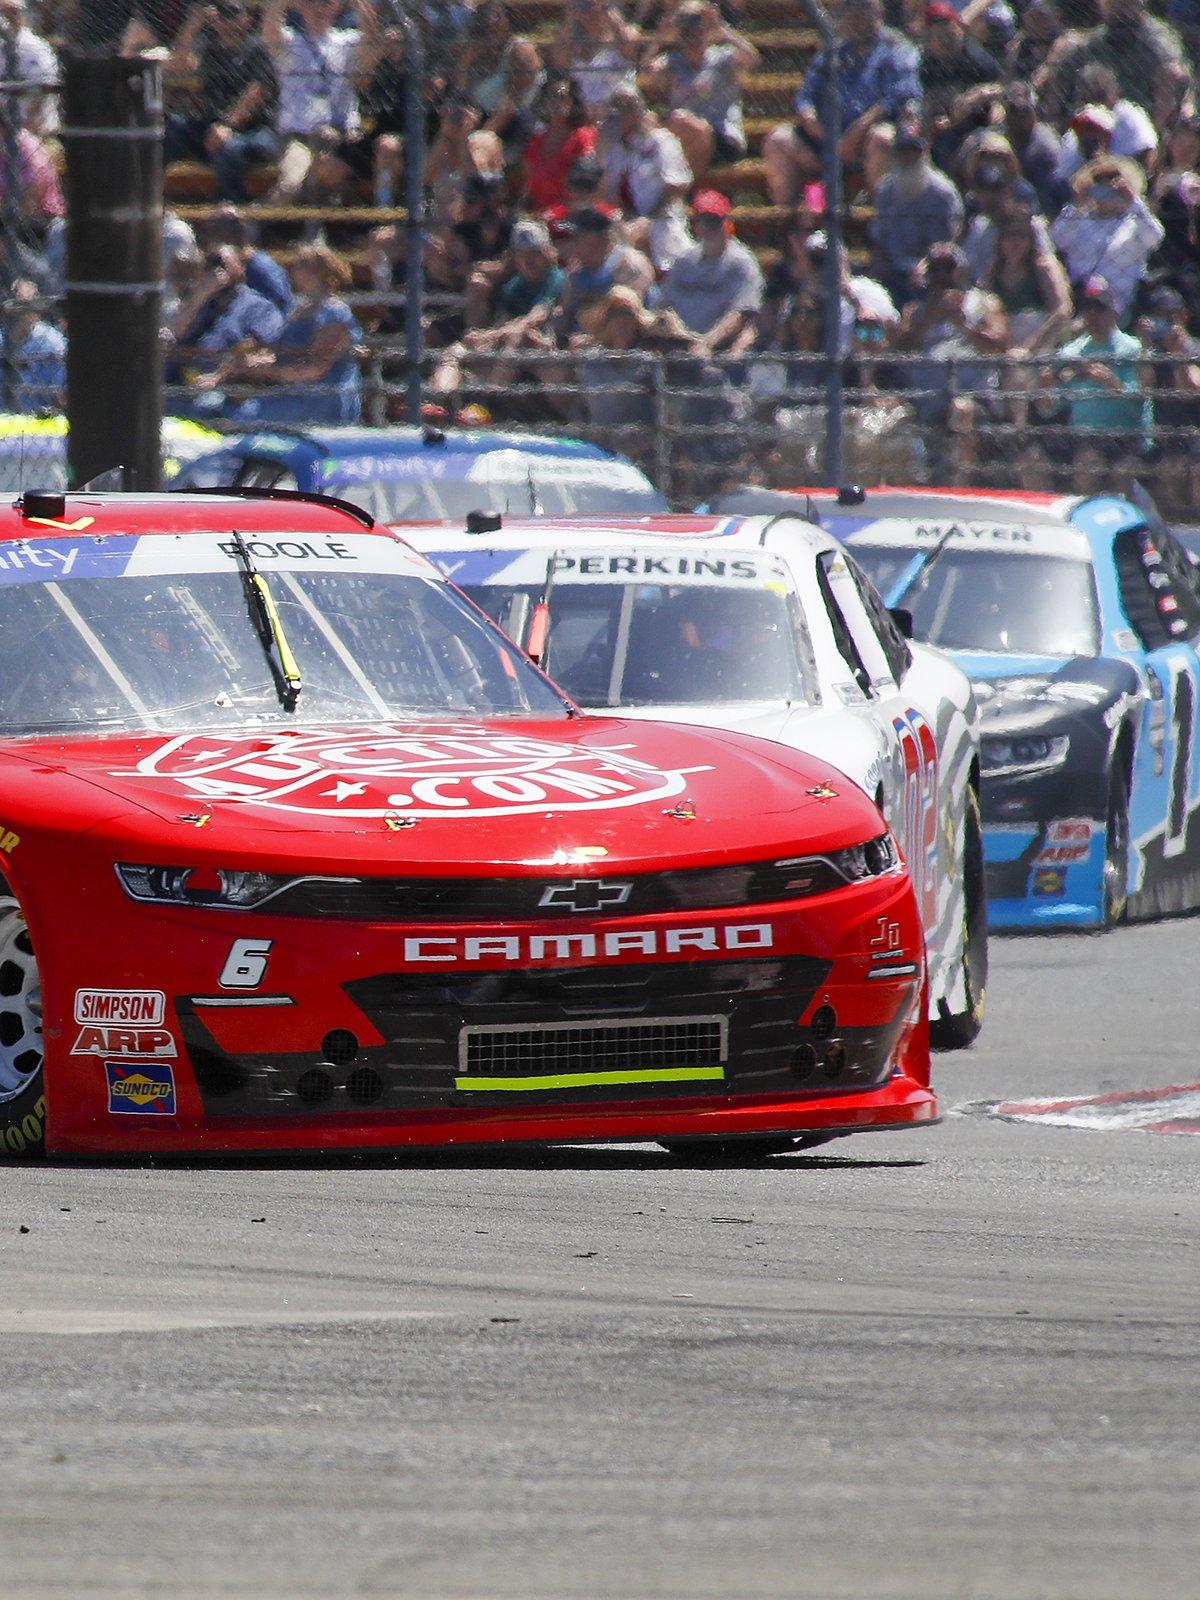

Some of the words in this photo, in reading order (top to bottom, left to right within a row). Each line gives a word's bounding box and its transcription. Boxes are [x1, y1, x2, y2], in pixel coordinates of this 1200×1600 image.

[915, 524, 1033, 542] MAYER
[217, 541, 358, 559] POOLE
[547, 555, 758, 579] PERKINS
[404, 924, 773, 962] CAMARO
[217, 938, 274, 990] 6
[81, 993, 157, 1021] SIMPSON
[74, 1027, 173, 1054] ARP
[113, 1081, 171, 1097] SUNOCO
